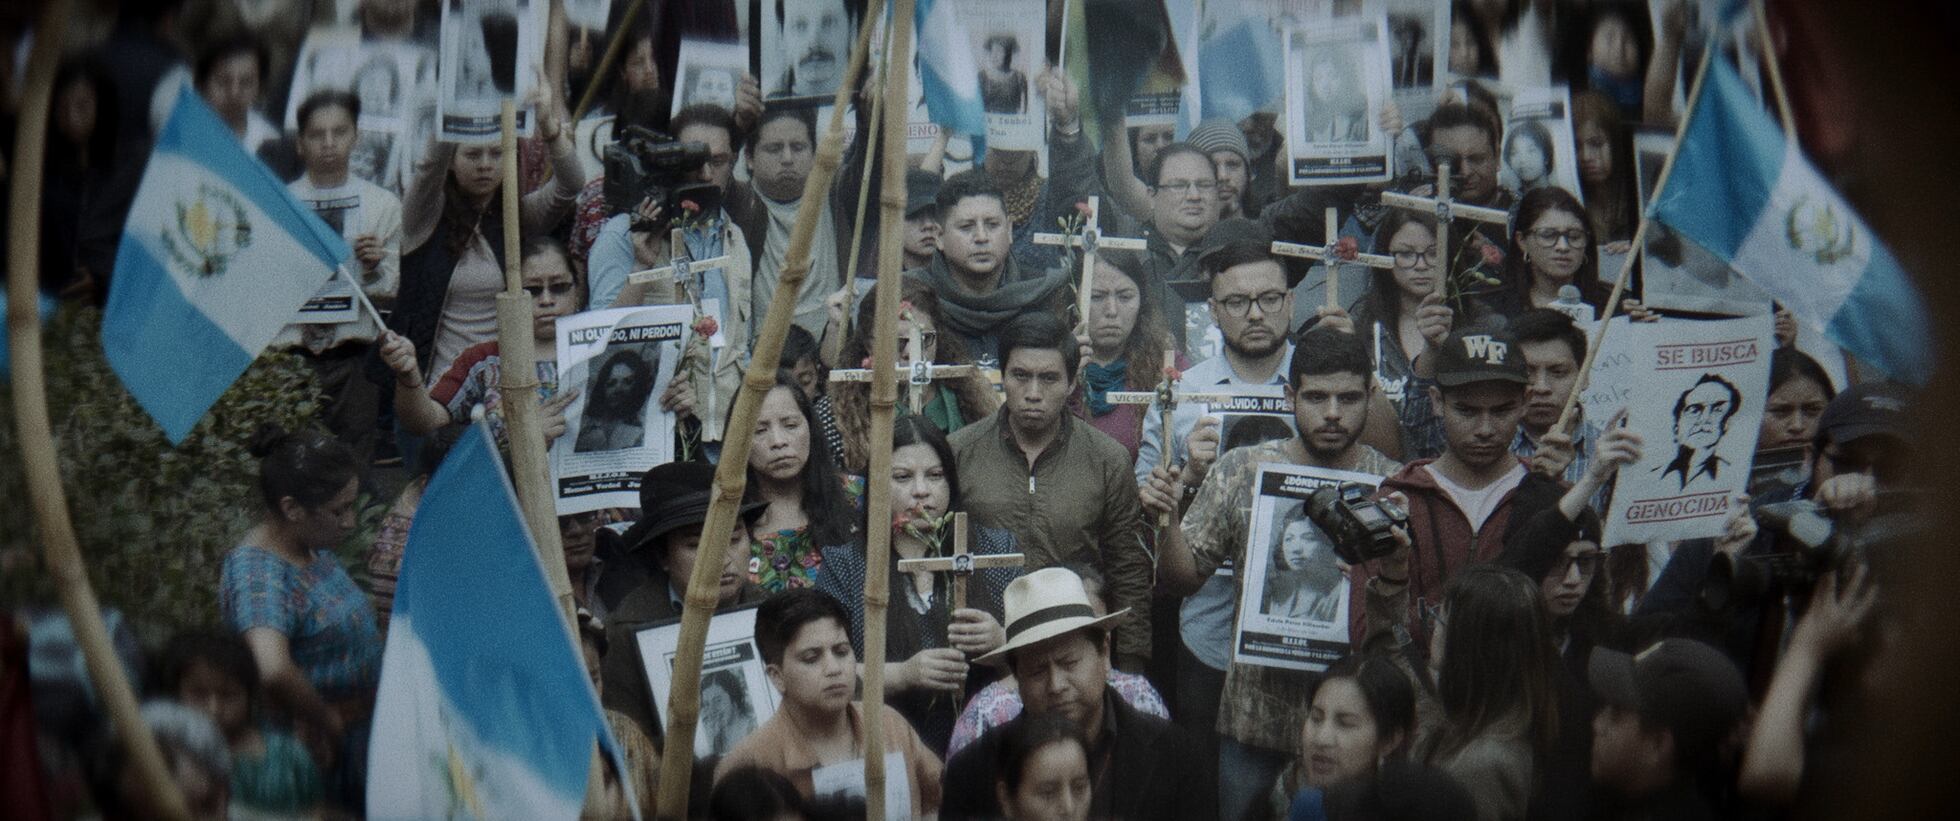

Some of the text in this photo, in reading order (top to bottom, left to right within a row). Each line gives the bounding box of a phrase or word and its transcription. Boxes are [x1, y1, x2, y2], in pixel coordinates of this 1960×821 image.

[571, 324, 681, 343] NI OLVDO, NI PERDON
[1462, 335, 1507, 365] WF
[1657, 343, 1759, 365] SE BUSCA
[1262, 398, 1274, 410] NI
[1625, 495, 1729, 520] GENOCIDA
